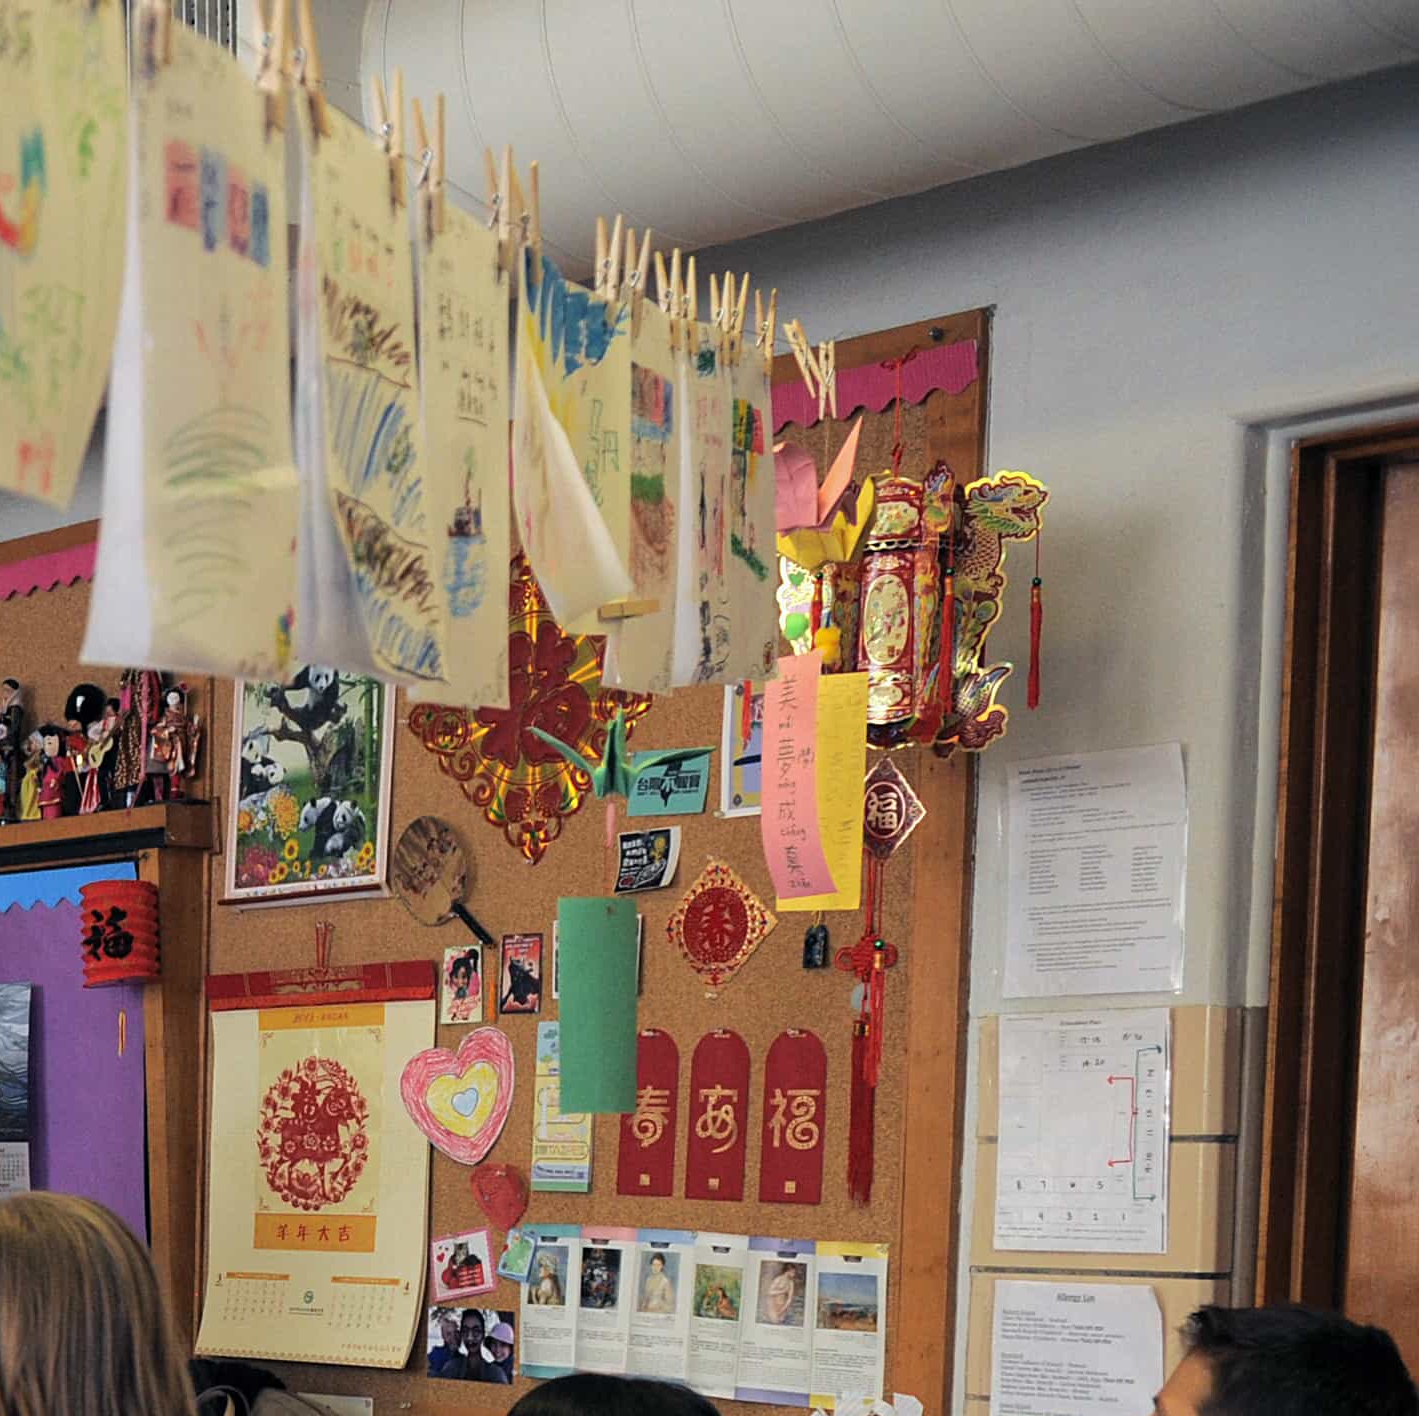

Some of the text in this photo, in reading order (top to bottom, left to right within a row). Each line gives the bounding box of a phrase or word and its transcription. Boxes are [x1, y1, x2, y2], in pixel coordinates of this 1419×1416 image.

[768, 1087, 822, 1151] 福
[276, 1224, 353, 1243] 羊年大吉
